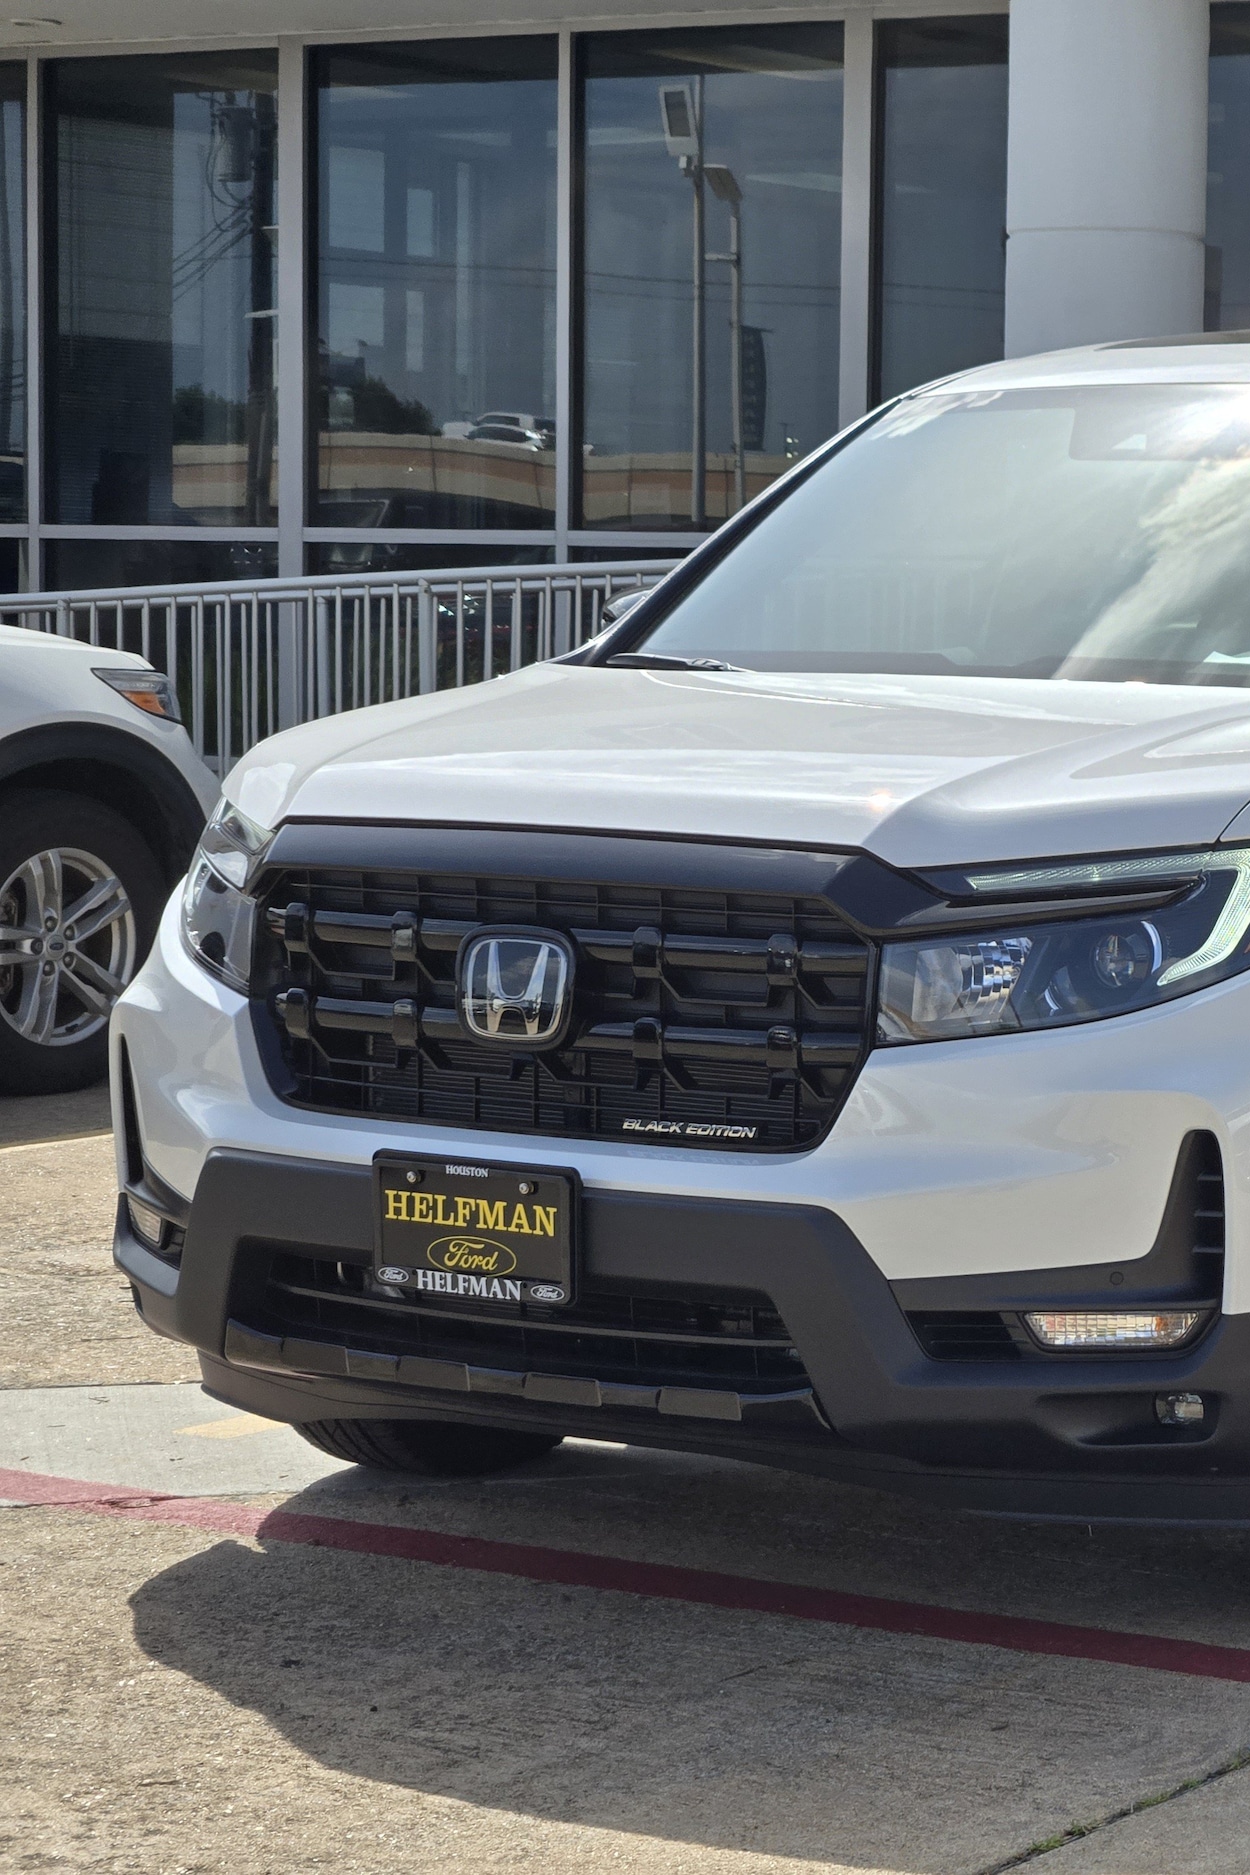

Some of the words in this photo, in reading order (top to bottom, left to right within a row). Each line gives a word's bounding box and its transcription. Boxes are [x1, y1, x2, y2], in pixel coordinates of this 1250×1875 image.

[622, 1118, 684, 1133] BLACK
[685, 1123, 757, 1138] EDITION
[445, 1164, 490, 1178] HOUSTON
[384, 1190, 557, 1237] HELFMAN
[443, 1239, 499, 1271] Ford
[383, 1268, 404, 1281] Ford
[416, 1268, 523, 1302] HELFMAN
[536, 1286, 559, 1299] Ford
